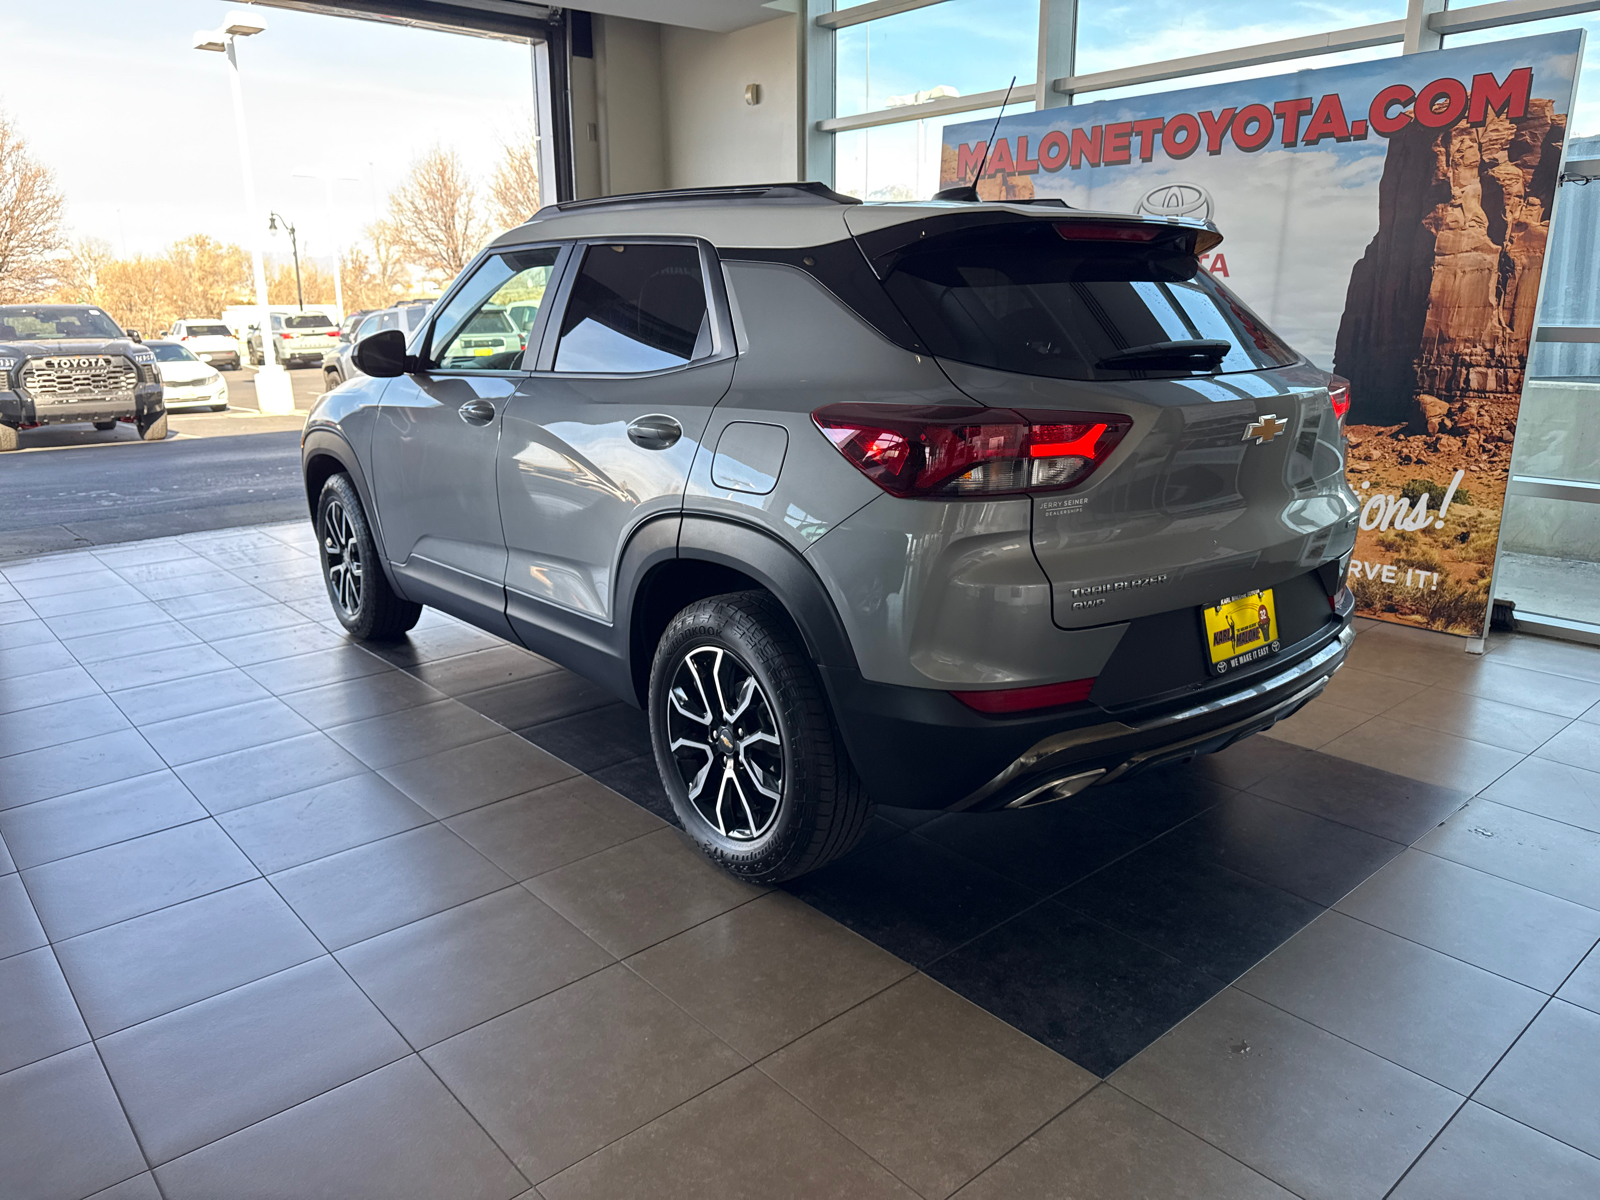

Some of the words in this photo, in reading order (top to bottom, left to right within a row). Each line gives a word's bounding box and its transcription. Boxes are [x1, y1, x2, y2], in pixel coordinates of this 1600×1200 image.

[957, 66, 1534, 180] MALONETOYOTA.COM
[53, 357, 107, 369] TOYOTA
[1039, 500, 1063, 510] JERRY
[1063, 497, 1089, 507] SEINER
[1070, 573, 1167, 599] TRAILBLAZER
[1405, 568, 1440, 591] IT!
[1260, 610, 1266, 620] 32
[1214, 628, 1232, 647] KARL
[1230, 659, 1238, 668] WE
[1239, 653, 1252, 664] MAKE
[1258, 646, 1269, 658] EASY
